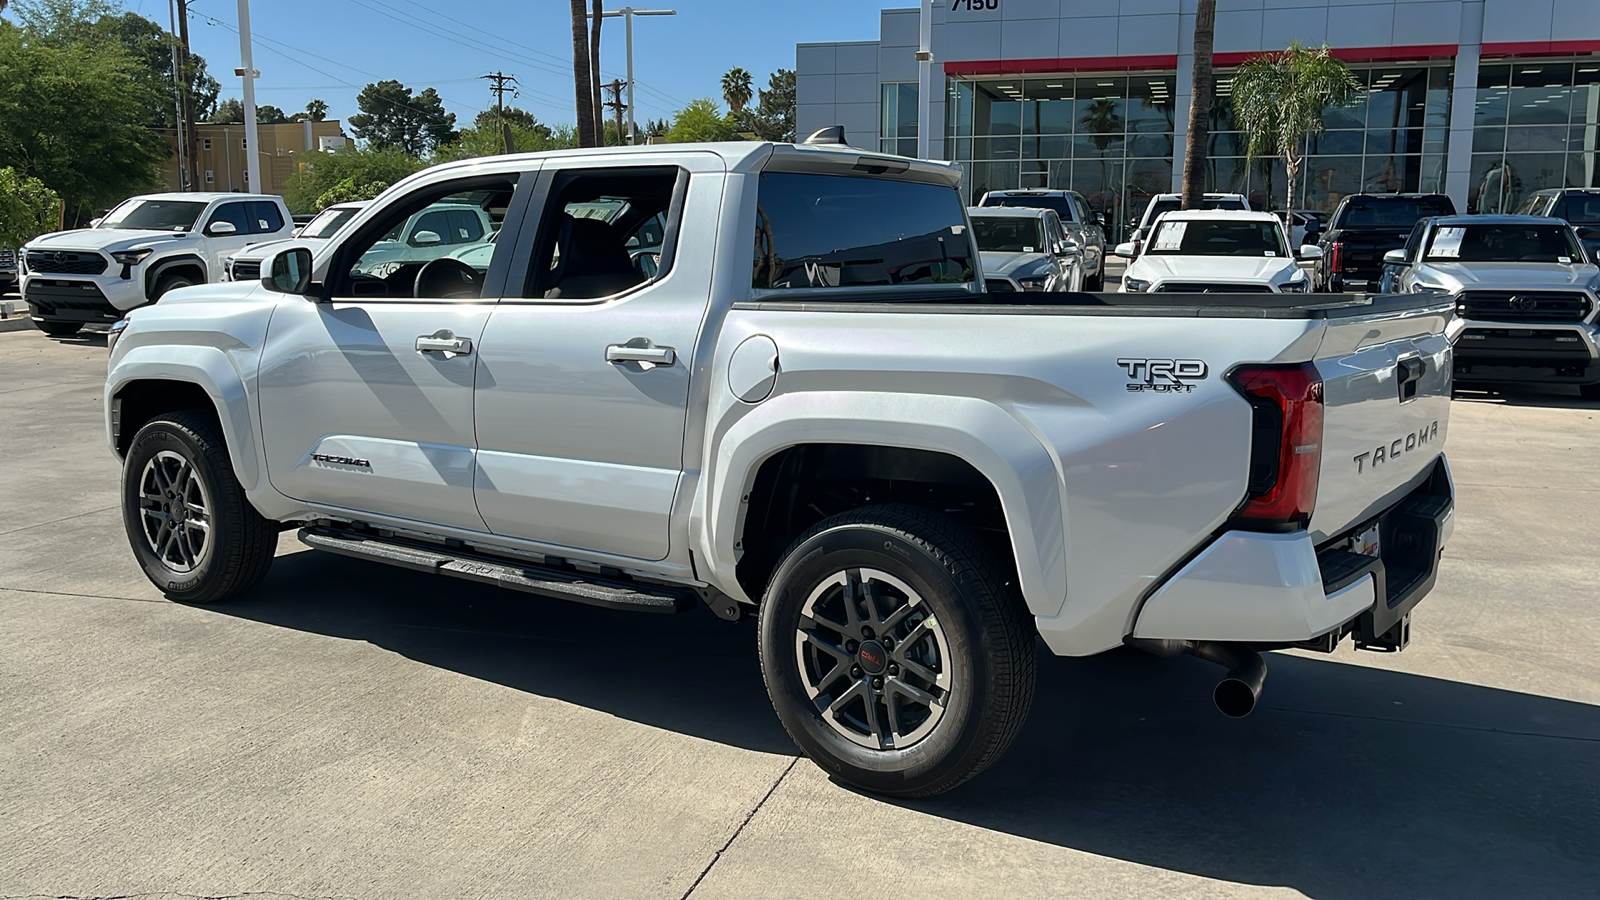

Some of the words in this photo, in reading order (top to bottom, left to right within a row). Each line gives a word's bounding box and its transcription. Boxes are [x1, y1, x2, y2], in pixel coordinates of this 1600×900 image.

[1117, 358, 1209, 385] TRD
[1126, 383, 1197, 393] SPORT
[1353, 421, 1438, 474] TACOMA
[310, 452, 370, 467] TACOMA
